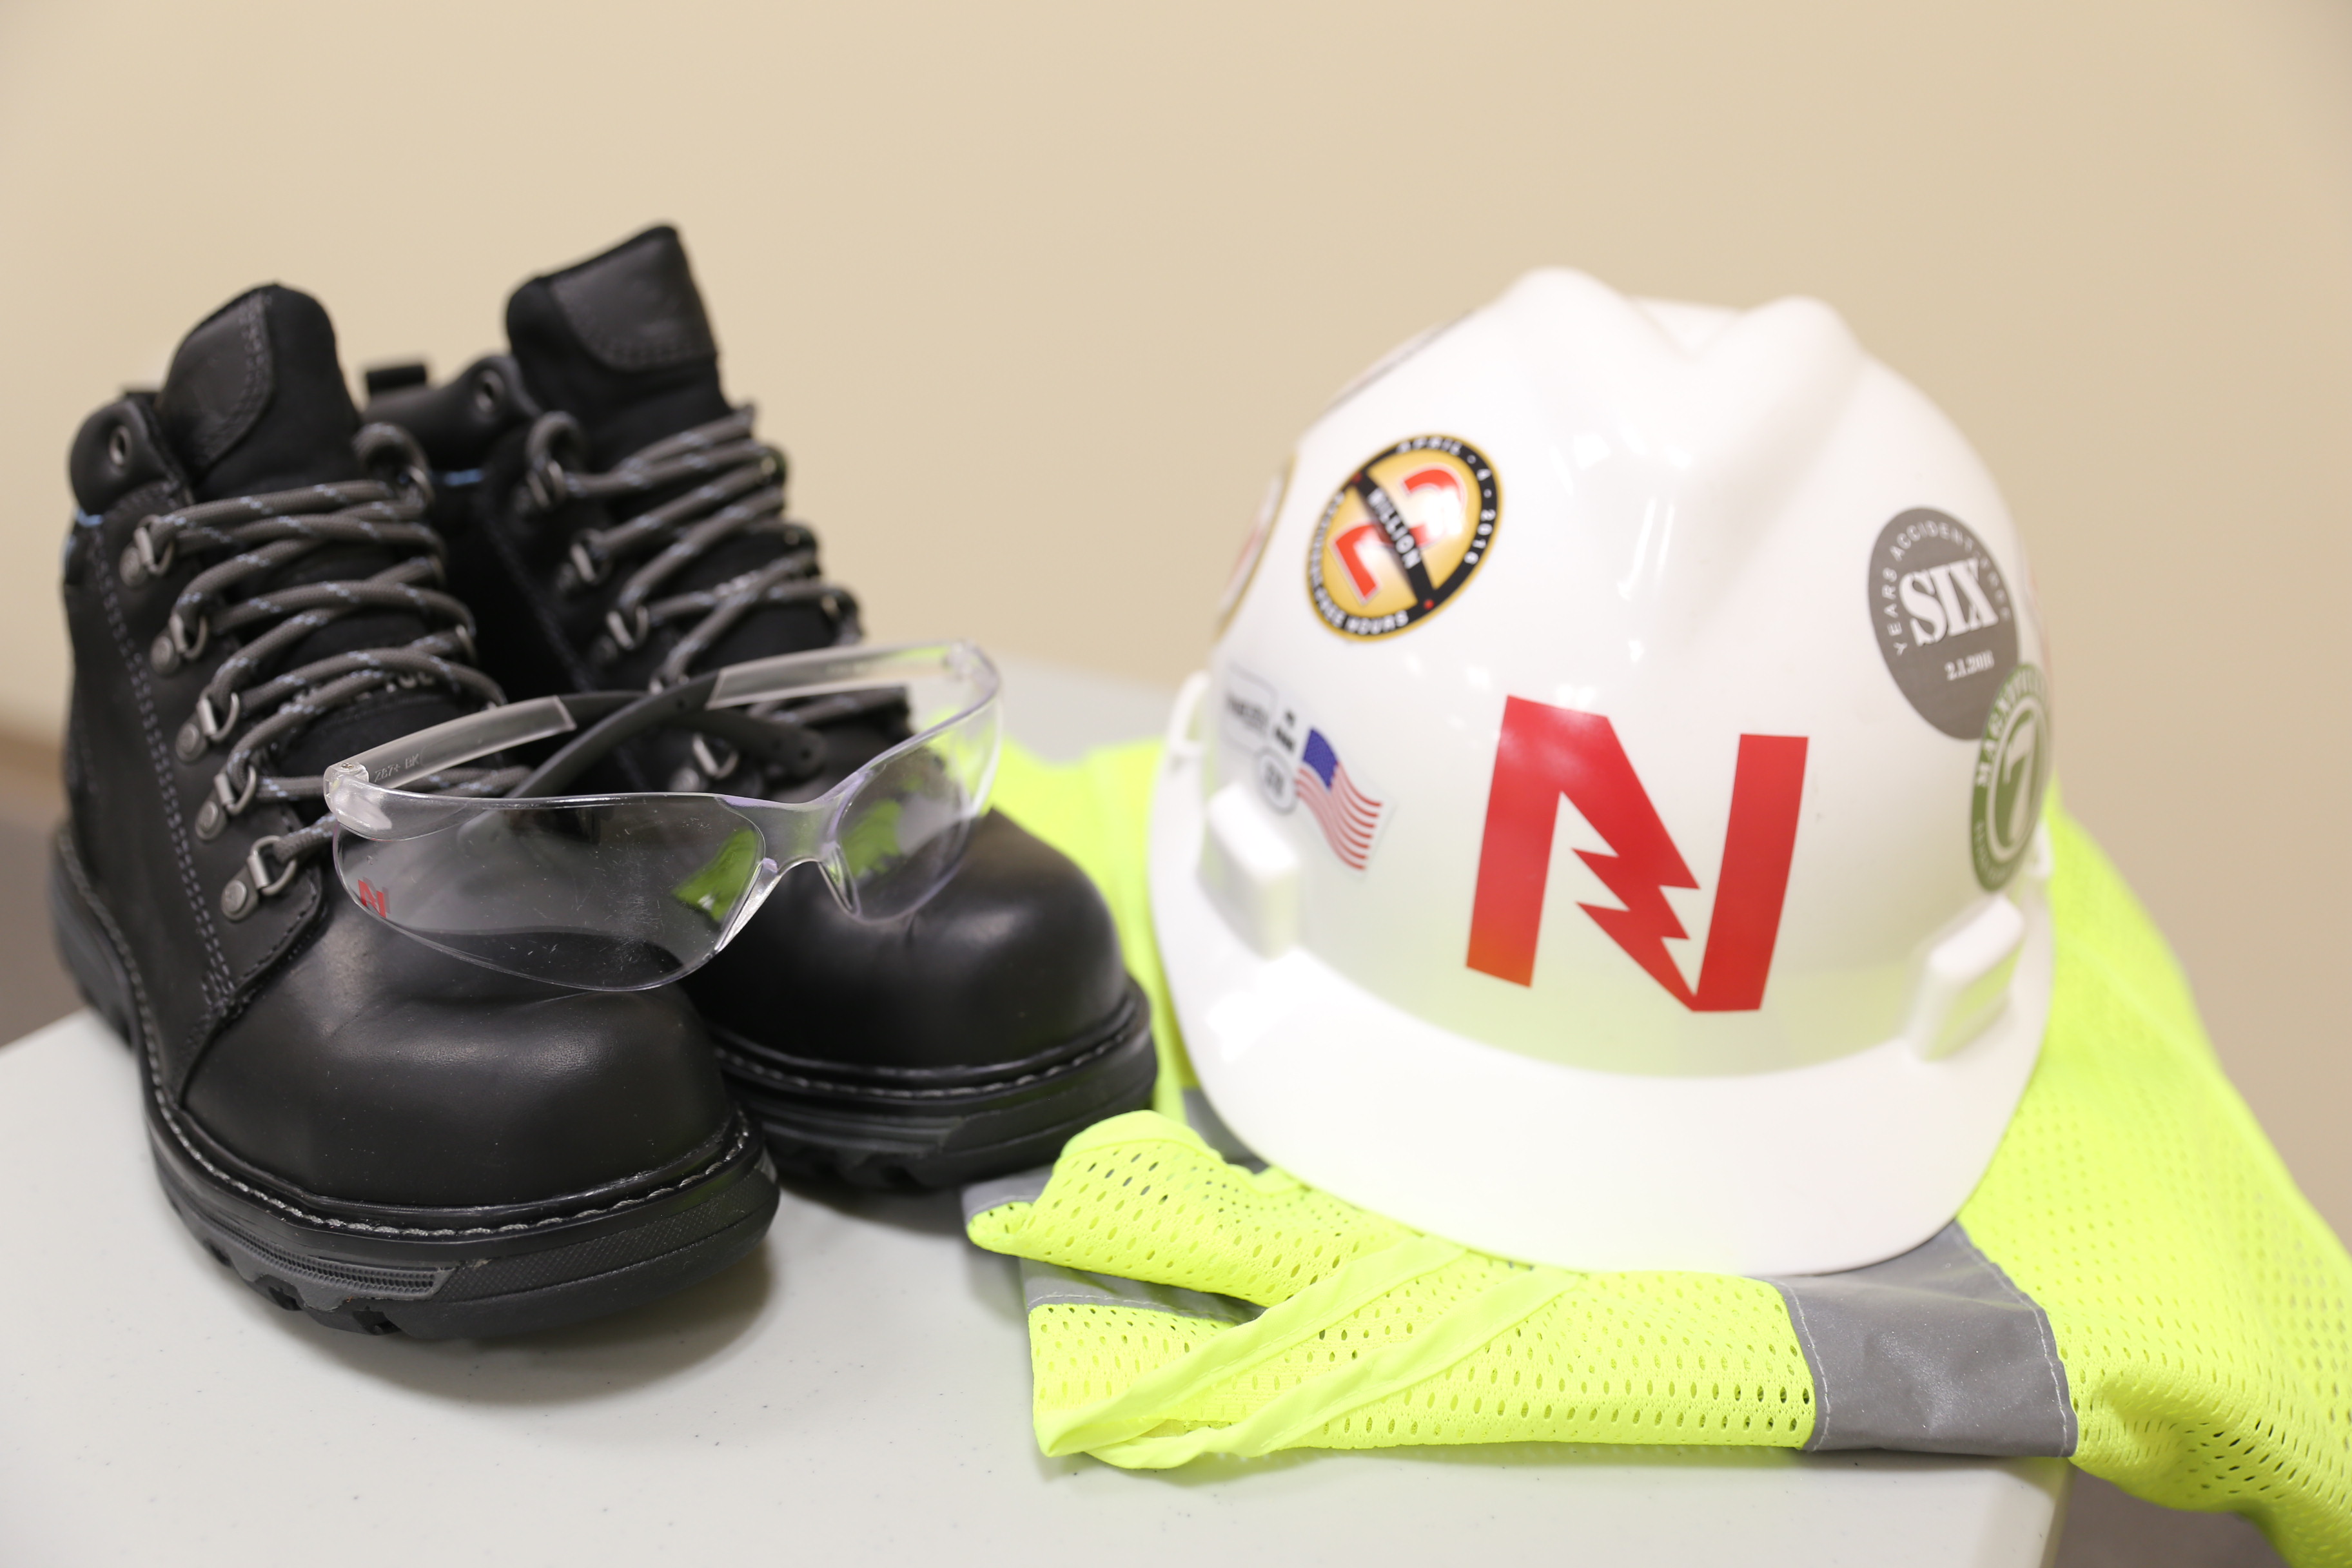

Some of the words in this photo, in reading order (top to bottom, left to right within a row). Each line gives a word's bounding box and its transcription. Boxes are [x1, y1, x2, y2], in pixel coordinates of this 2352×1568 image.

[1367, 487, 1421, 569] MILLION
[1881, 567, 1908, 656] YEARS
[1899, 557, 1999, 647] SIX
[374, 764, 400, 783] Z87+
[1465, 695, 1809, 1014] N
